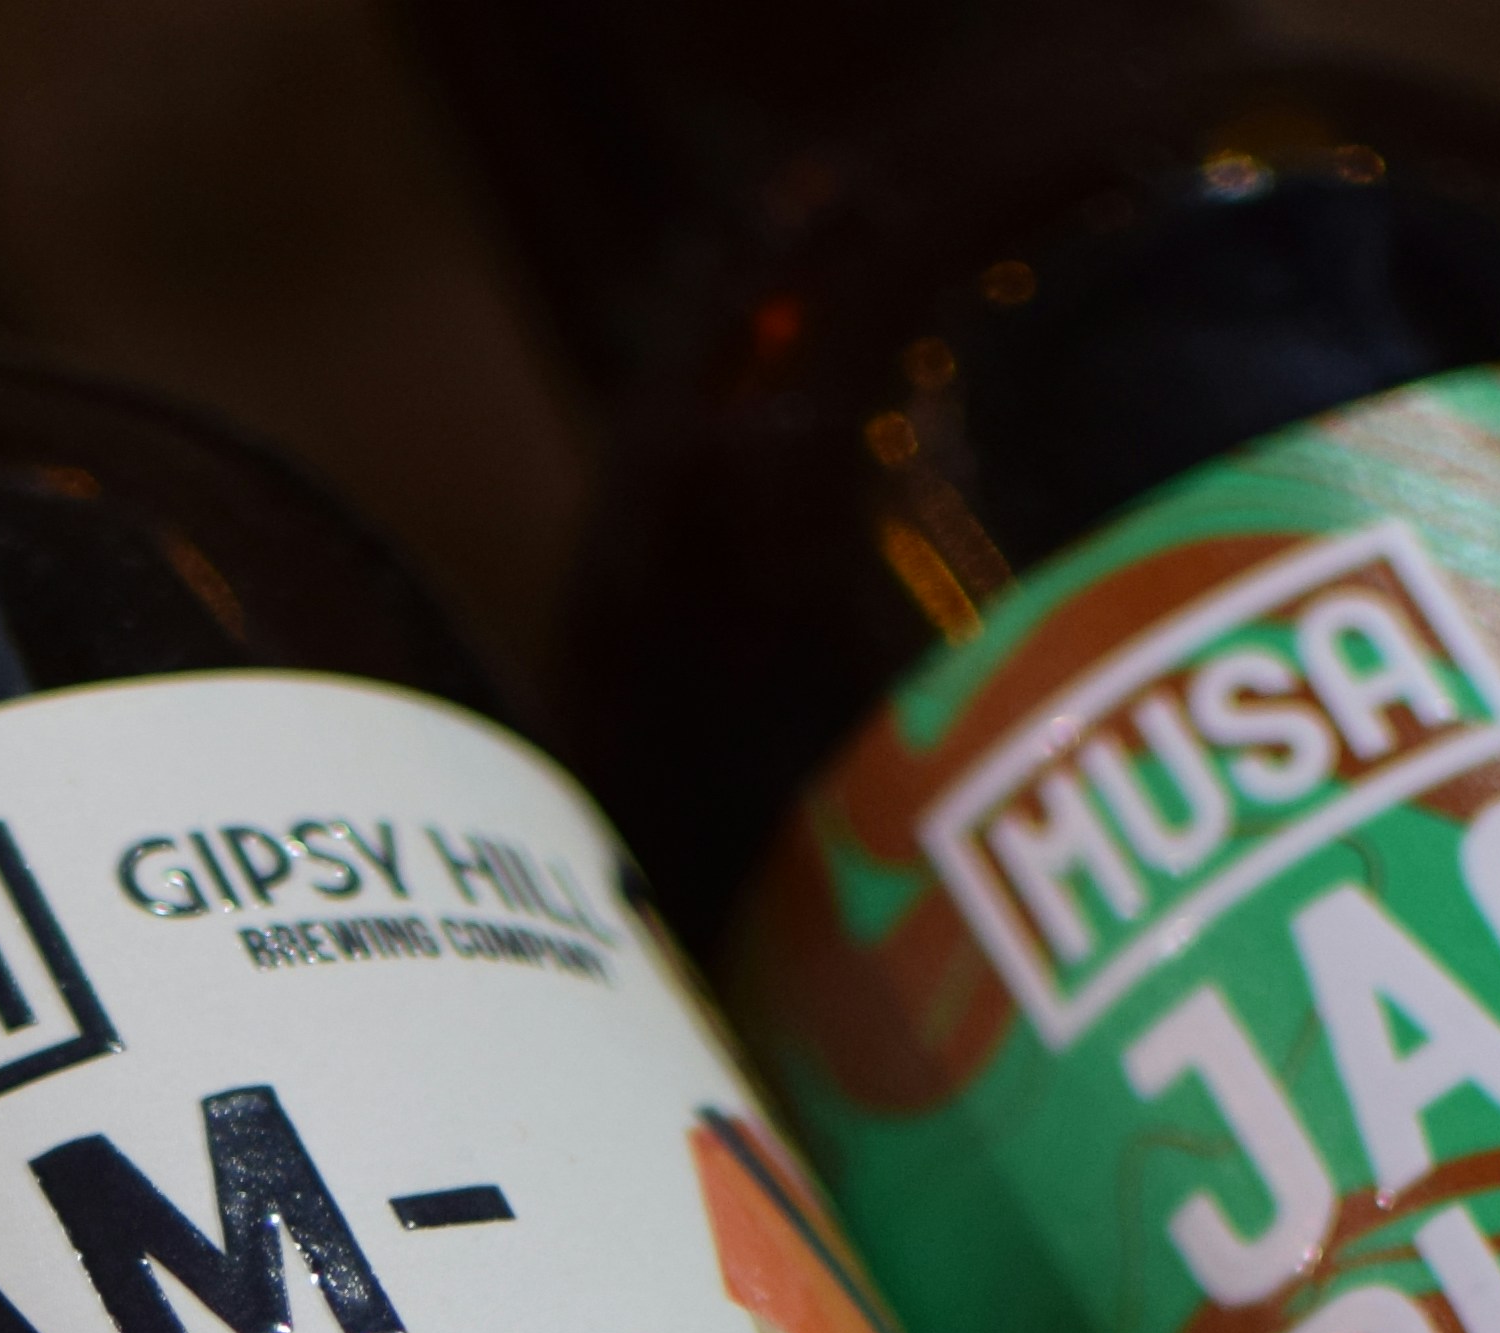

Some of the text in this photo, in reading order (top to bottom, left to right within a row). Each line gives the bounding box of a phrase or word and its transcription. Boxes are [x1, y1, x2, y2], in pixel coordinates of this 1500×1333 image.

[987, 590, 1458, 964] MUSA
[117, 819, 615, 948] GIPSY HILL
[238, 915, 442, 972] BREWING
